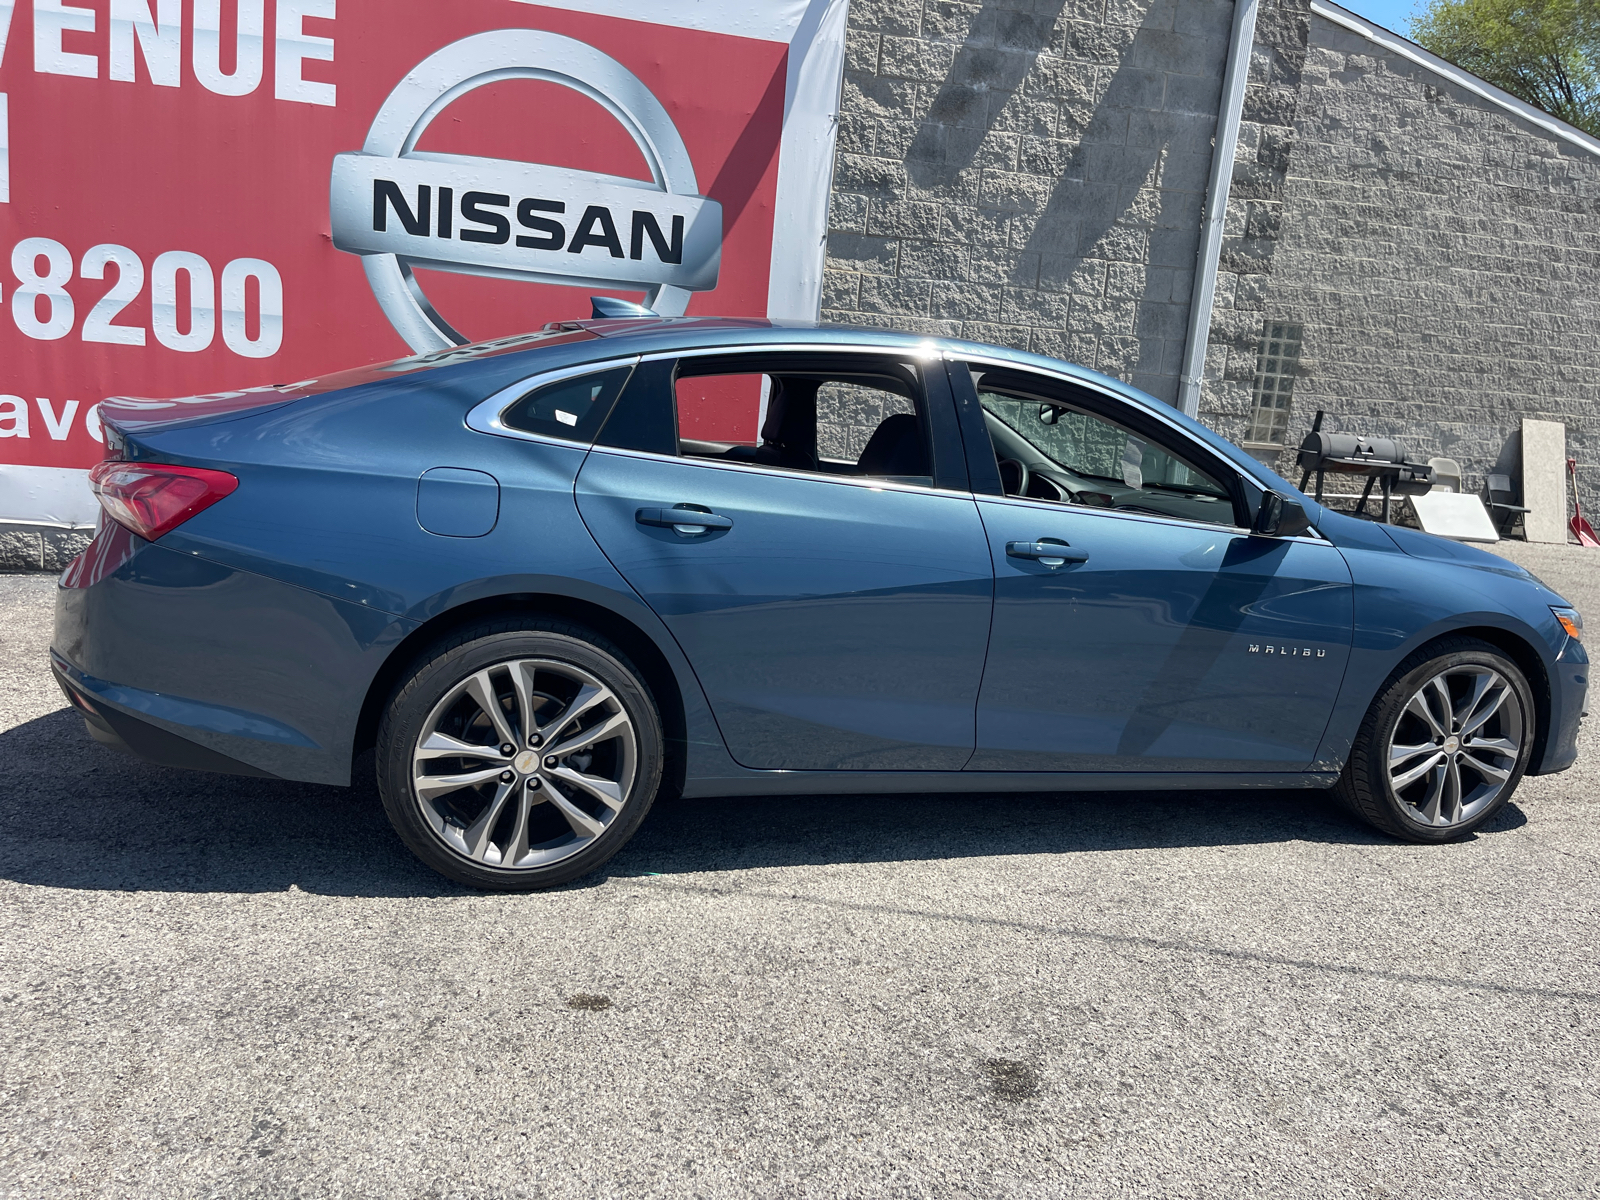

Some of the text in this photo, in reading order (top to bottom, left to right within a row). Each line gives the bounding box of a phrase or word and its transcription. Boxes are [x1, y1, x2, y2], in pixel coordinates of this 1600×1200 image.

[0, 0, 337, 107] ENUE
[373, 179, 685, 265] NISSAN
[0, 237, 284, 359] 8200
[1248, 643, 1326, 658] MALIBU
